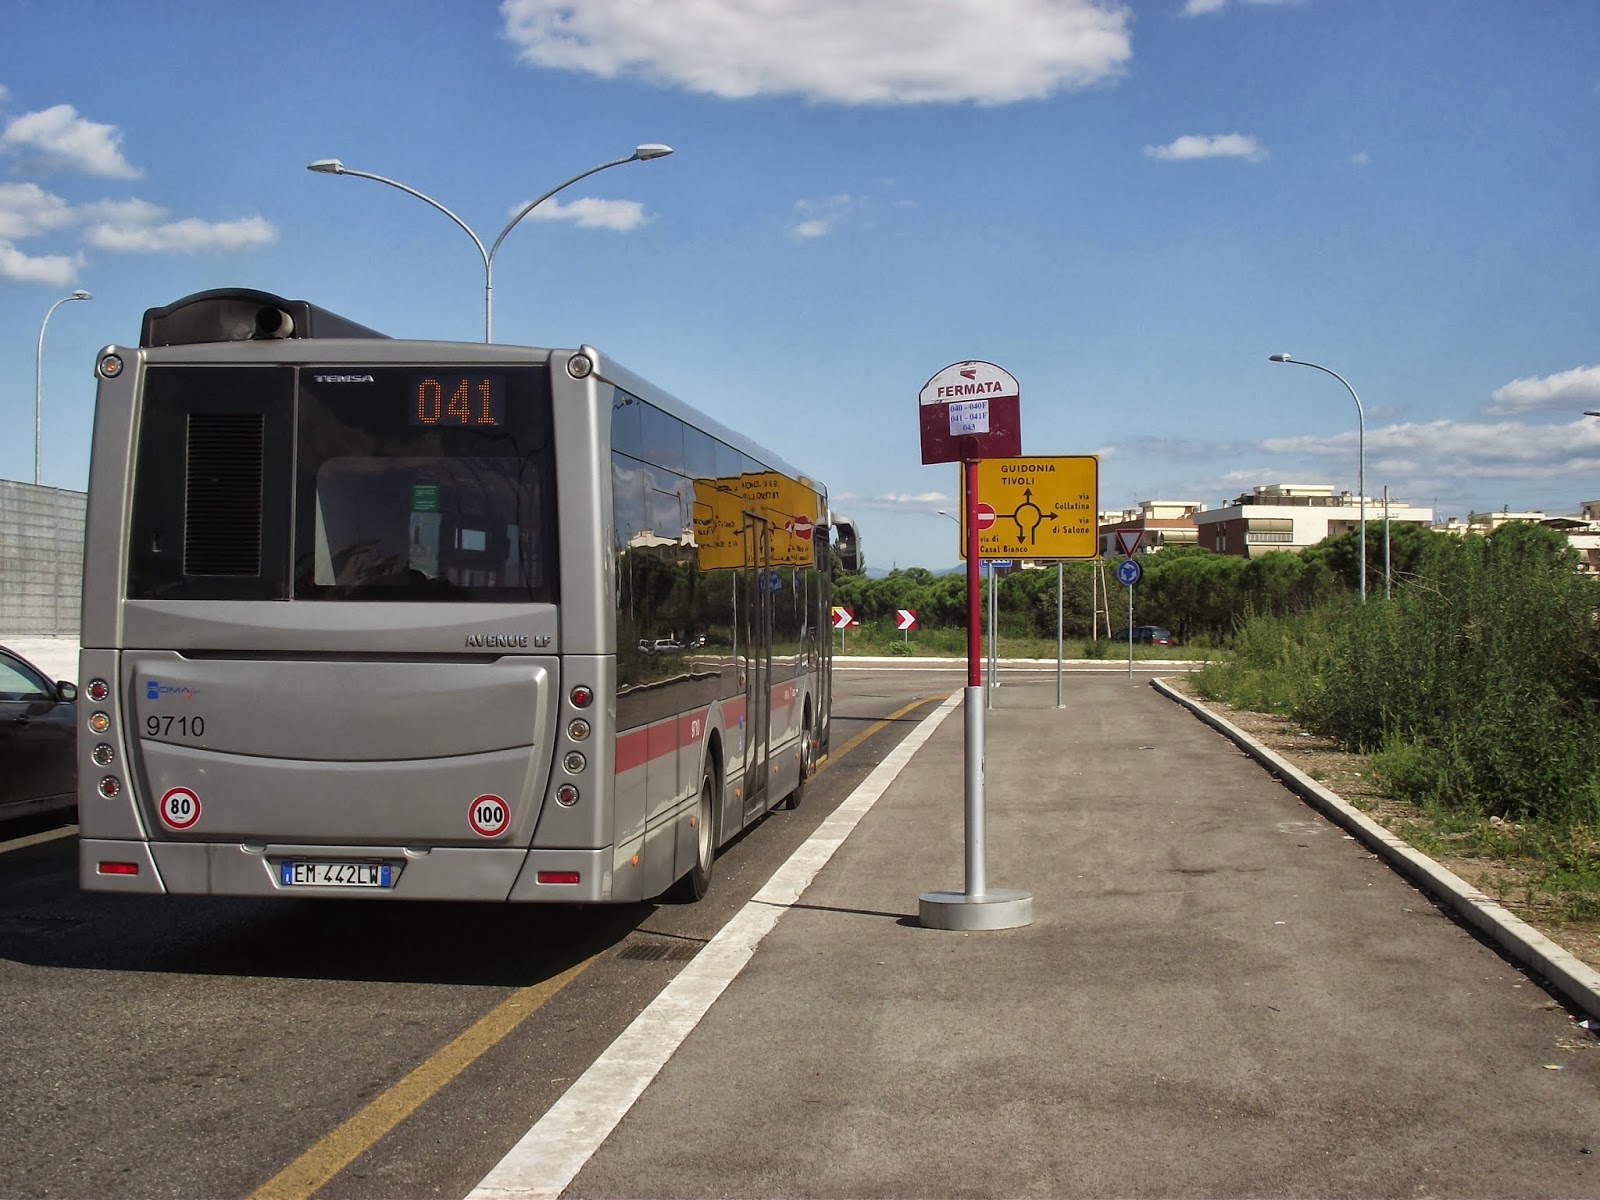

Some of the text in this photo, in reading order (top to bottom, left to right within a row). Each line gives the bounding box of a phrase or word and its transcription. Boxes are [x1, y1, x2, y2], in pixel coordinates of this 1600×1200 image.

[314, 374, 375, 383] TEMSA
[937, 381, 1003, 398] FERMATA
[418, 379, 495, 423] 041
[950, 405, 963, 413] 040
[950, 415, 963, 423] 041
[962, 423, 976, 432] 043
[1001, 464, 1056, 473] GUIDONIA
[1001, 477, 1035, 485] TIVOLI
[1079, 492, 1090, 500] via
[1055, 502, 1090, 510] Collatina
[1079, 516, 1090, 524] via
[1052, 525, 1090, 534] di Salone
[980, 534, 999, 543] via di
[980, 545, 1028, 553] Casal Bianco
[465, 634, 552, 648] AVENUE LF
[147, 715, 205, 737] 9710
[170, 798, 190, 815] 80
[476, 806, 503, 823] 100
[294, 864, 316, 883] EM
[323, 864, 379, 884] 442LW
